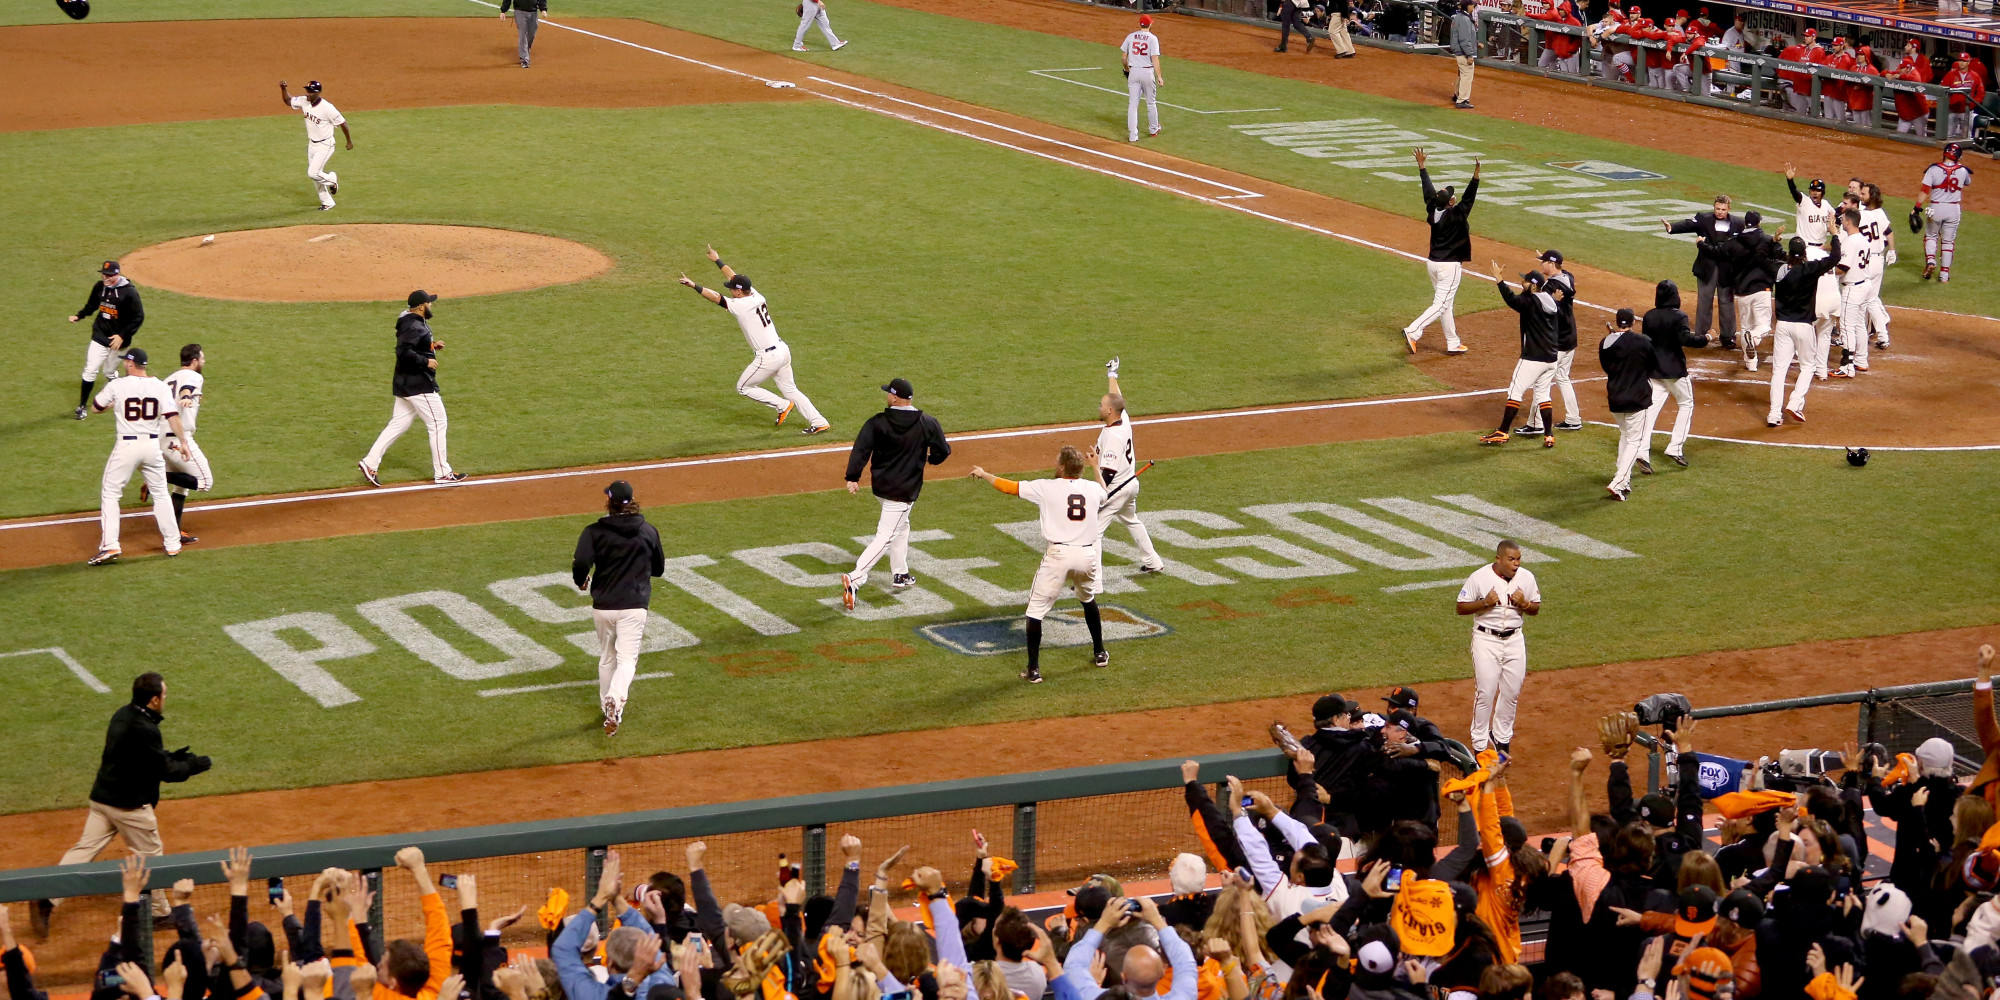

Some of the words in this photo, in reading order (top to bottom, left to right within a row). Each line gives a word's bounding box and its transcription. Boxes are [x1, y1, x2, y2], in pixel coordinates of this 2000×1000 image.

[1132, 41, 1148, 56] 52
[1858, 221, 1880, 243] 50
[1858, 248, 1871, 269] 34
[756, 303, 771, 328] 12
[124, 397, 159, 421] 60
[1125, 438, 1133, 465] 2
[1067, 494, 1086, 521] 8
[223, 494, 1639, 708] POSTSEASON
[1700, 765, 1720, 779] FOX
[1711, 781, 1717, 790] 1
